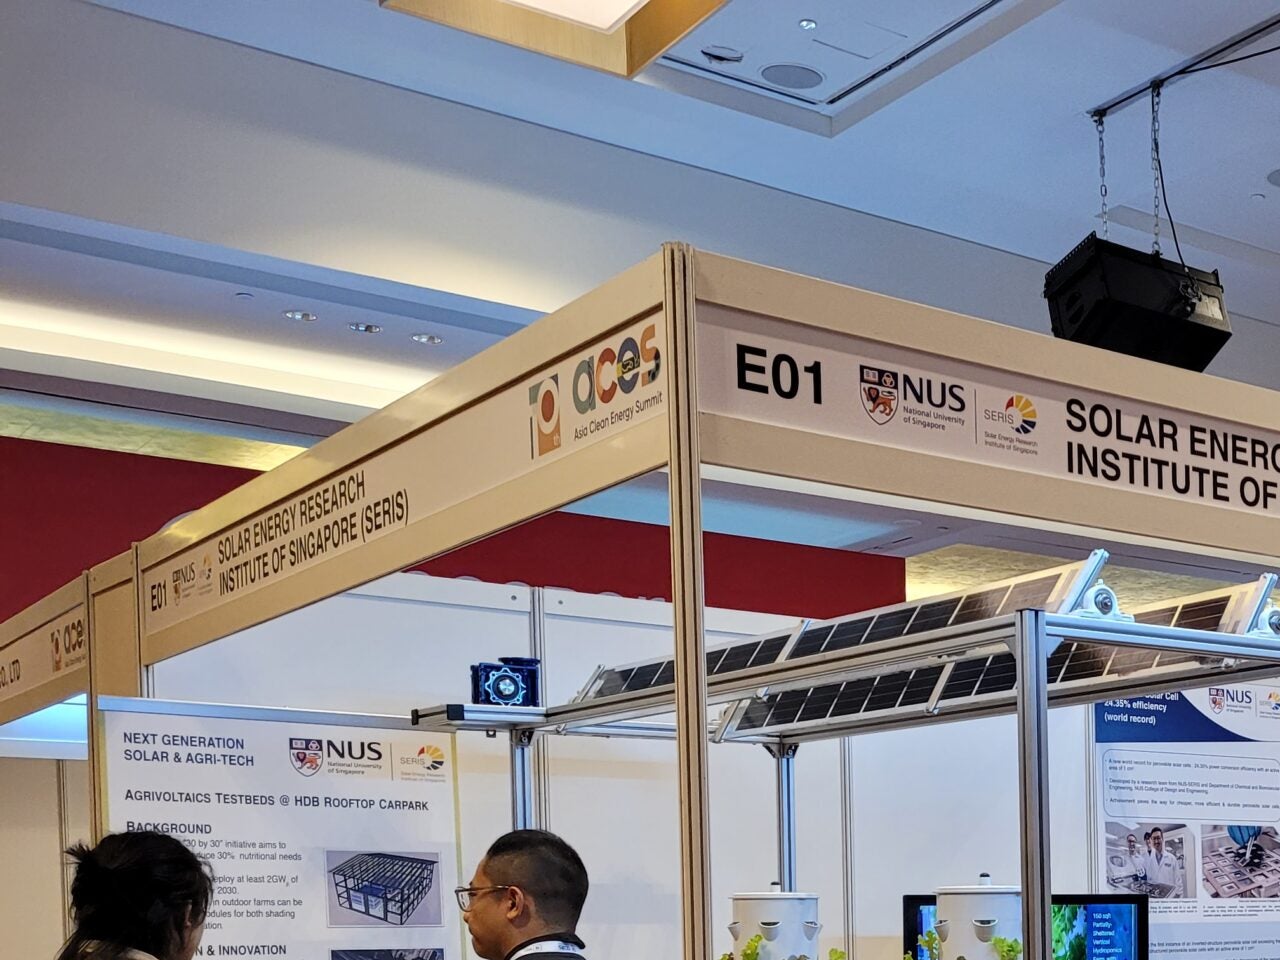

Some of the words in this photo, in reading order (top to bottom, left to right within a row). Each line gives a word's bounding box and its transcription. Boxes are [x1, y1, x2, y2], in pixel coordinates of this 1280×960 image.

[573, 324, 661, 414] aces
[736, 343, 822, 405] E01
[903, 374, 966, 412] NUS
[574, 427, 588, 440] Asia
[590, 417, 609, 434] Clean
[610, 407, 634, 426] Energy
[635, 391, 662, 413] Summit
[903, 406, 932, 418] National
[933, 411, 965, 426] University
[903, 416, 911, 424] of
[912, 417, 945, 431] Singapore
[984, 409, 1014, 425] SERIS
[1066, 398, 1178, 452] SOLAR
[1067, 441, 1230, 502] INSTITUTE
[1240, 476, 1278, 509] OF
[218, 527, 251, 564] SOLAR
[254, 504, 297, 548] ENERGY
[301, 470, 366, 528] RESEARCH
[219, 554, 269, 596] INSTITUTE
[272, 543, 286, 572] OF
[290, 512, 357, 566] SINGAPORE
[361, 488, 408, 543] (SERIS)
[181, 562, 195, 584] NUS
[151, 580, 167, 612] E01
[1165, 692, 1179, 701] Cell
[1226, 689, 1252, 704] NUS
[1132, 701, 1167, 713] efficiency
[1104, 712, 1128, 722] (world
[1130, 715, 1156, 726] record)
[123, 732, 158, 745] NEXT
[162, 734, 244, 749] GENERATION
[124, 749, 169, 762] SOLAR
[173, 752, 182, 763] &
[186, 752, 254, 766] AGRI-TECH
[326, 740, 382, 761] NUS
[400, 757, 425, 765] SERIS
[125, 789, 211, 803] AGRIVOLTAICS
[215, 792, 275, 805] TESTBEDS
[279, 795, 290, 806] @
[295, 796, 319, 807] HDB
[324, 797, 375, 809] ROOFTOP
[379, 799, 429, 811] CARPARK
[126, 821, 212, 834] BACKGROUND
[225, 840, 257, 849] initiative
[240, 852, 277, 860] nutritional
[279, 852, 302, 861] needs
[222, 898, 251, 906] outdoor
[254, 898, 275, 906] farms
[246, 910, 263, 918] both
[265, 910, 295, 919] shading
[219, 944, 287, 956] INNOVATION
